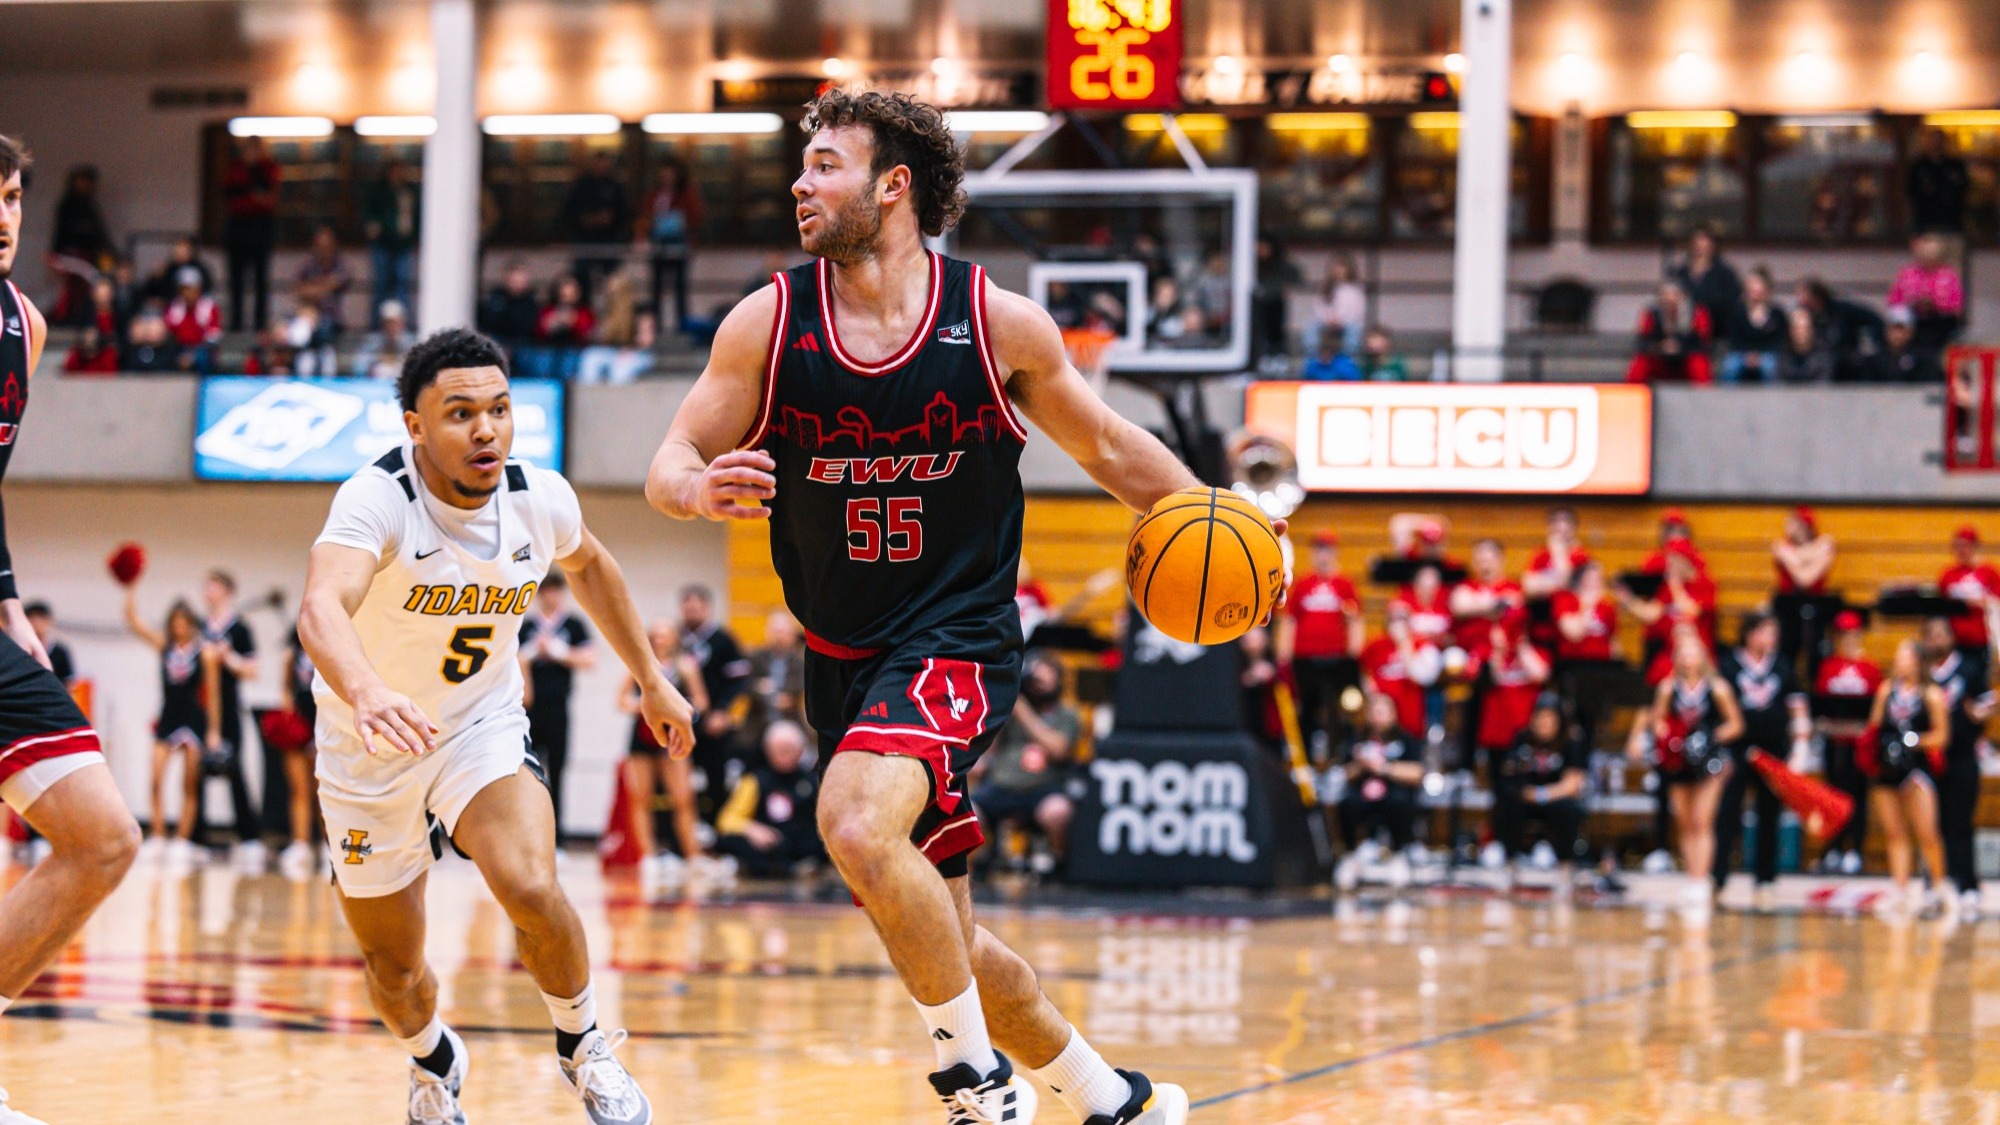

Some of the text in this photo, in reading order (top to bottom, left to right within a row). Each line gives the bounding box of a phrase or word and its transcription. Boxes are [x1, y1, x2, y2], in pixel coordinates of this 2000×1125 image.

[1070, 27, 1155, 100] 26
[951, 322, 968, 337] SKY
[806, 451, 966, 484] EWU
[846, 496, 923, 562] 55
[403, 580, 538, 615] IDAHO
[440, 624, 496, 686] 5
[1090, 758, 1248, 811] nom
[1099, 806, 1258, 863] nom
